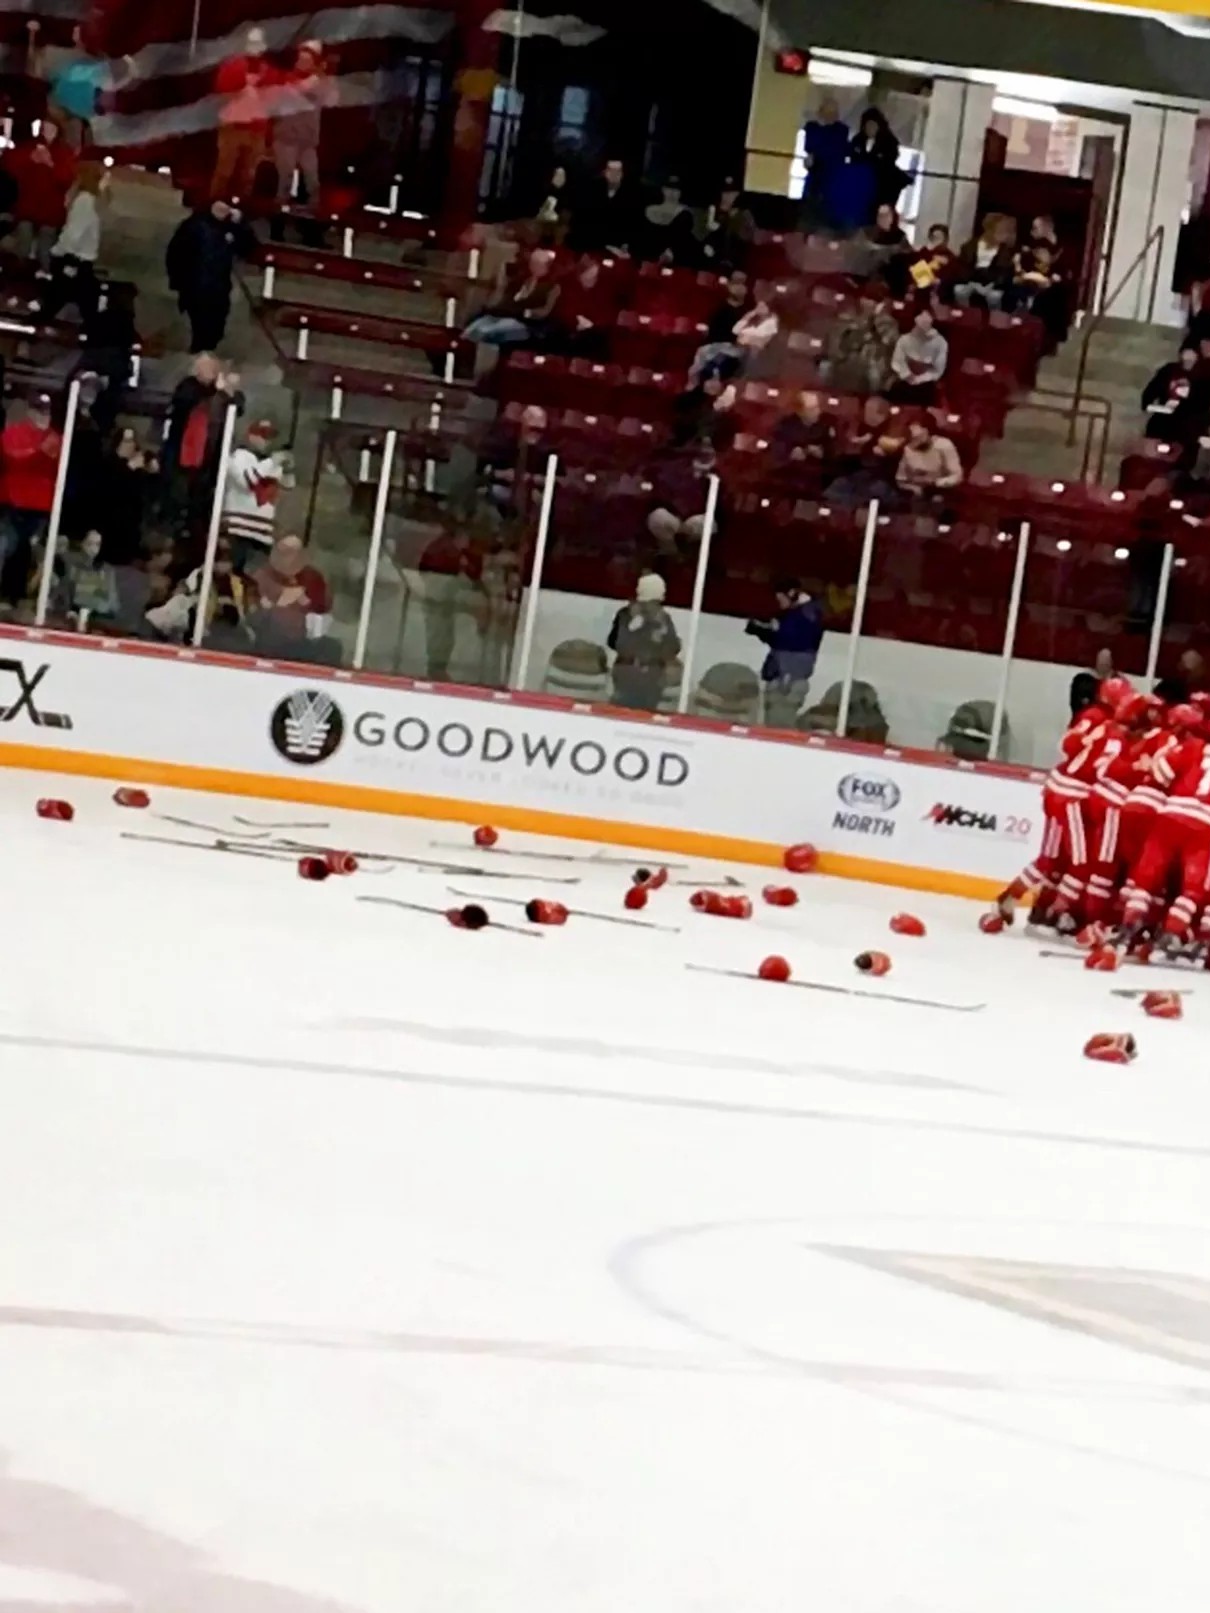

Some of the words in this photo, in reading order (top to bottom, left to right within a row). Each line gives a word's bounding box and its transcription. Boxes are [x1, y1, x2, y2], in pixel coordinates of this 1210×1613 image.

[353, 710, 690, 787] GOODWOOD
[851, 778, 886, 799] FOX
[831, 811, 896, 837] NORTH
